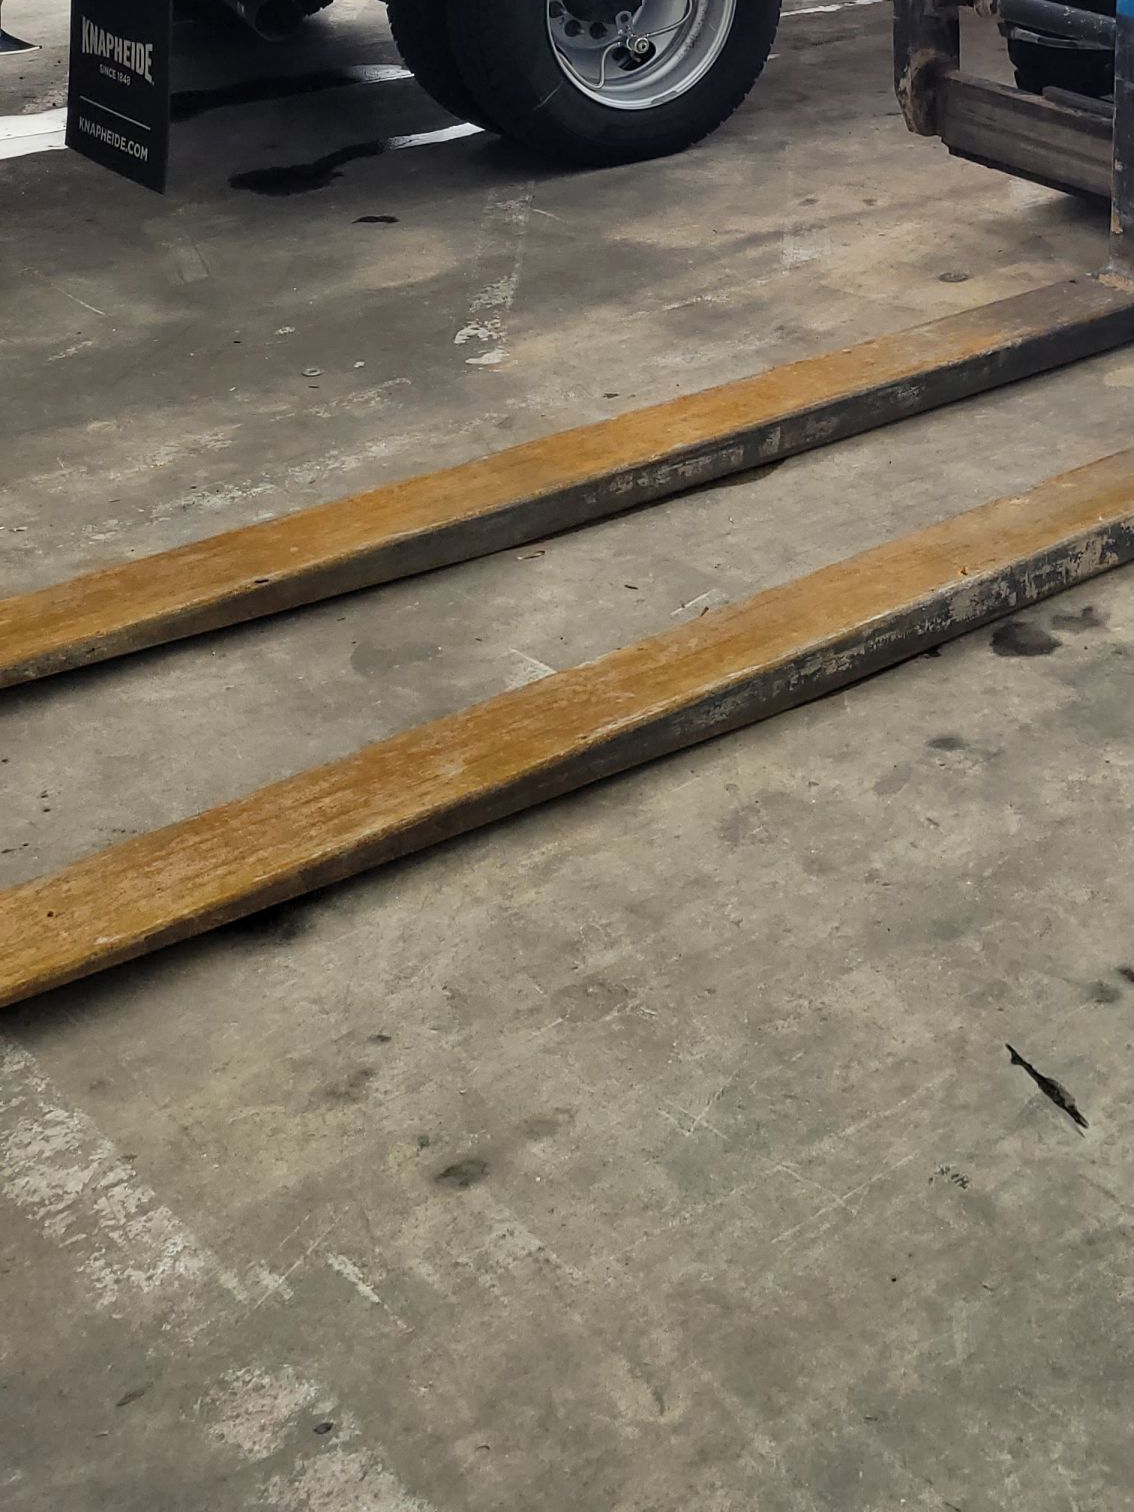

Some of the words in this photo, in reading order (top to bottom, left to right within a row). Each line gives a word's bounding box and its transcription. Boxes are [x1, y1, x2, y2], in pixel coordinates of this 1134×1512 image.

[81, 15, 153, 84] KNAPHEIDE
[99, 63, 117, 80] SINCE
[116, 70, 132, 87] 1848
[78, 115, 148, 163] KNAPHEIDE.COM
